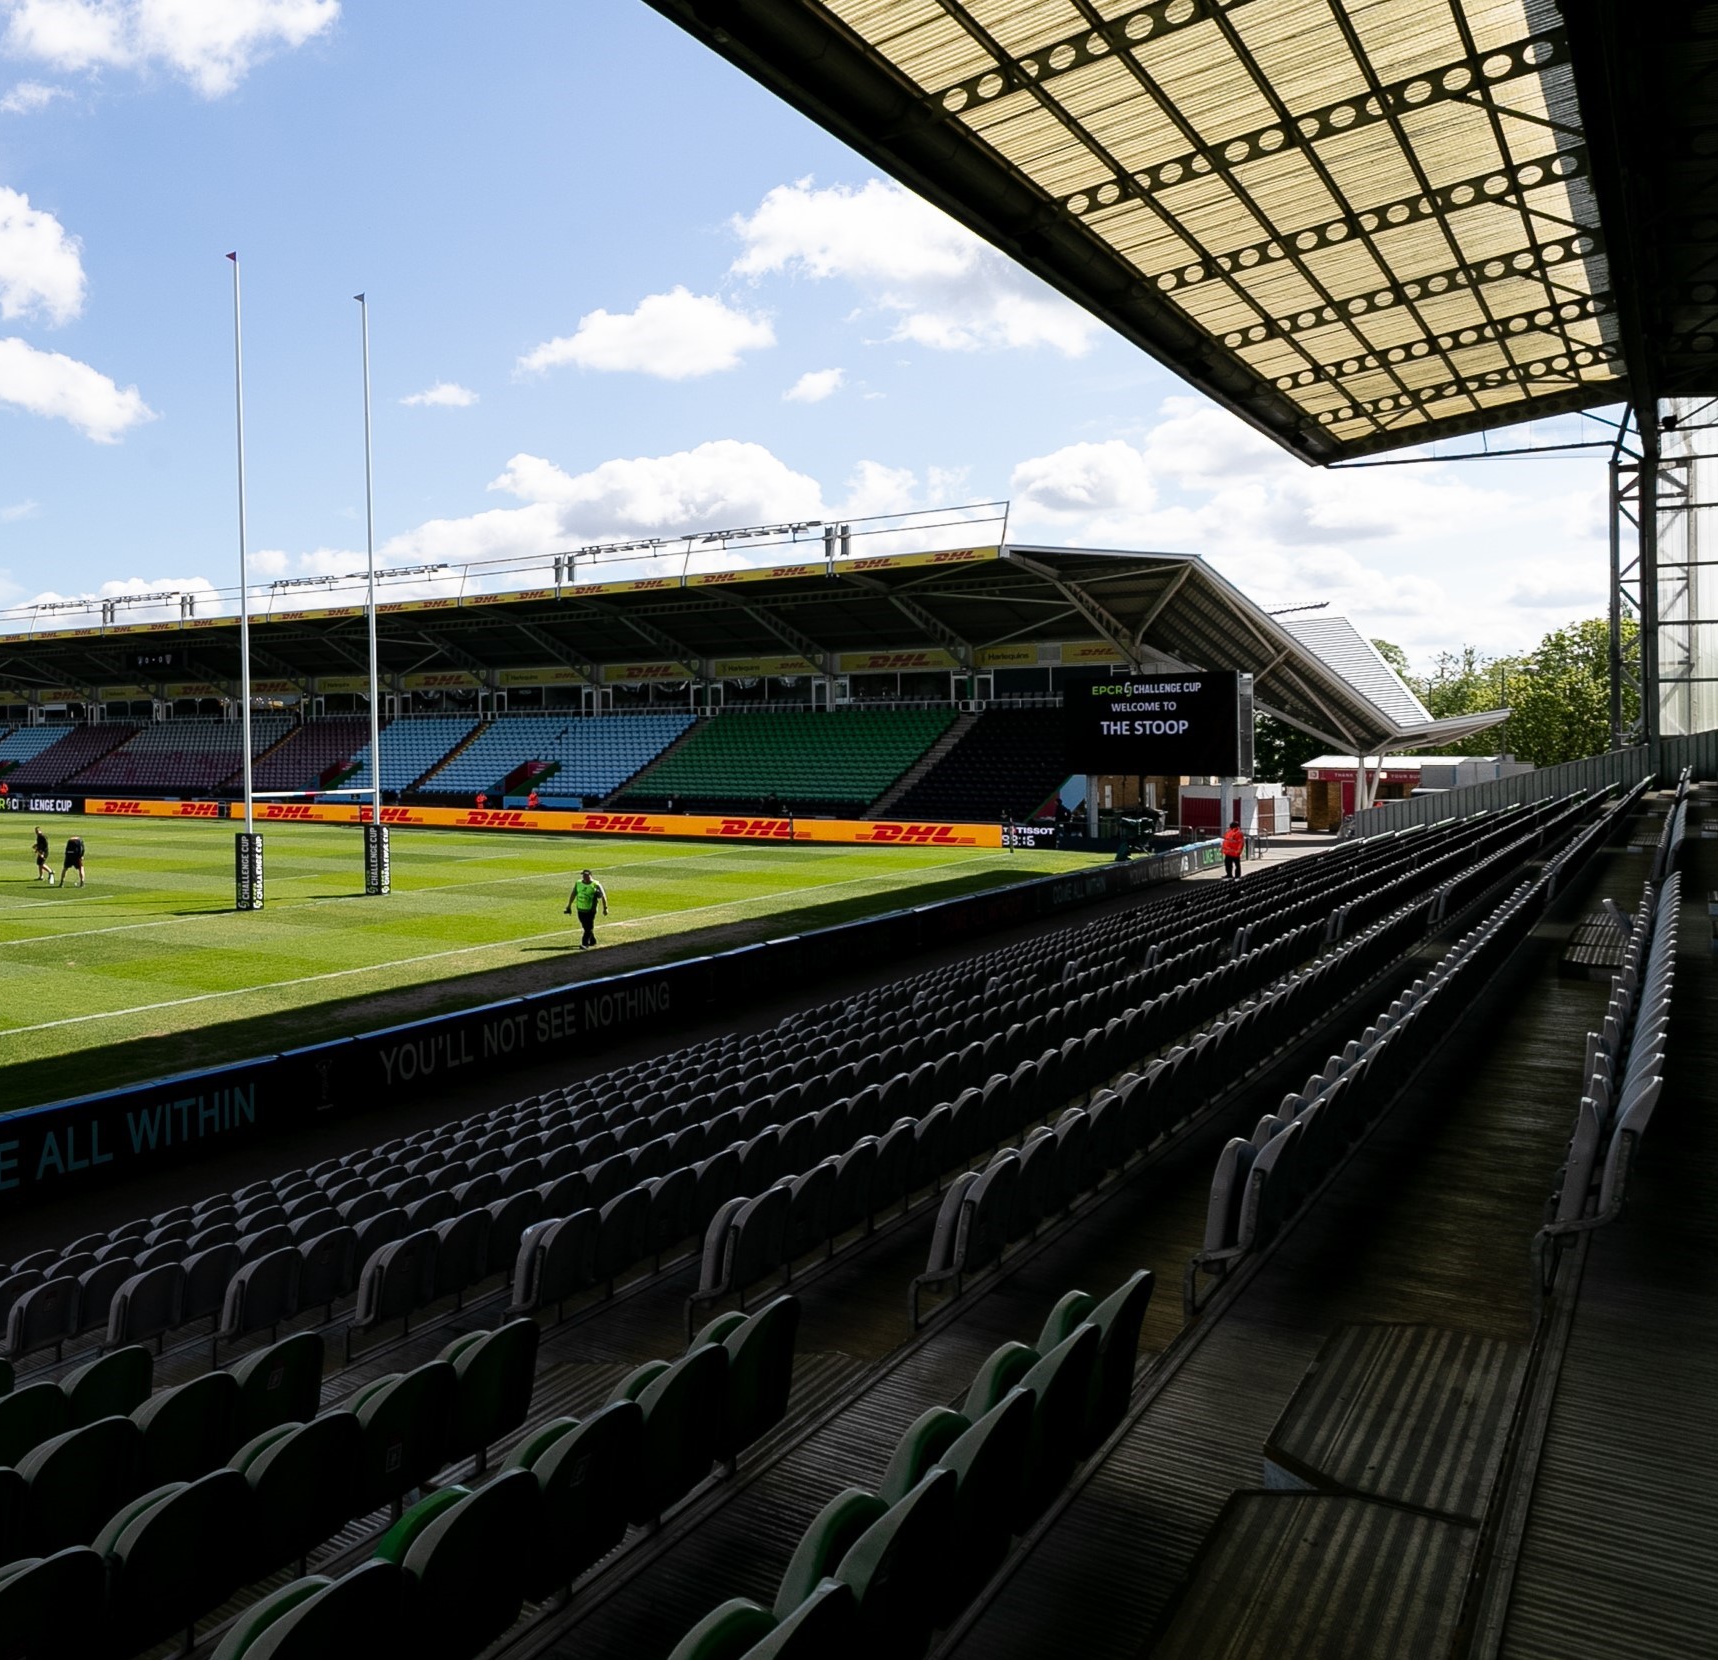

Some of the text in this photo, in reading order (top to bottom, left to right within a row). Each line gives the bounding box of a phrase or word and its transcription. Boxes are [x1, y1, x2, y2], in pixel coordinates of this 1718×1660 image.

[934, 551, 975, 562] DHL
[853, 559, 892, 569] DHL
[703, 574, 737, 583] DHL
[772, 567, 808, 577] DHL
[575, 586, 604, 595] DHL
[634, 580, 666, 590] DHL
[474, 596, 500, 604] DHL
[519, 592, 547, 600] DHL
[423, 601, 449, 609] DHL
[327, 609, 351, 617] DHL
[1081, 648, 1115, 656] DHL
[868, 654, 931, 669] DHL
[626, 666, 674, 679] DHL
[424, 675, 466, 686] DHL
[1092, 682, 1202, 696] EPCR CHALLENGE CUP
[1111, 702, 1177, 712] WELCOME TO
[1101, 720, 1189, 735] THE STOOP
[56, 800, 73, 812] CUP
[104, 802, 143, 814] DHL
[267, 806, 314, 819] DHL
[362, 808, 413, 823] DHL
[467, 812, 527, 828] DHL
[585, 816, 652, 832] DHL
[720, 820, 796, 838] DHL
[370, 828, 378, 843] CUP
[872, 825, 960, 844] DHL
[1016, 827, 1055, 835] TISSOT
[242, 836, 250, 853] CUP
[370, 844, 379, 886] CHALLENGE
[241, 854, 250, 900] CHALLENGE
[256, 854, 264, 900] CHALLENGE
[380, 982, 671, 1086] YOU'LL NOT SEE NOTHING
[36, 1120, 116, 1181] ALL
[125, 1083, 256, 1155] WITHIN
